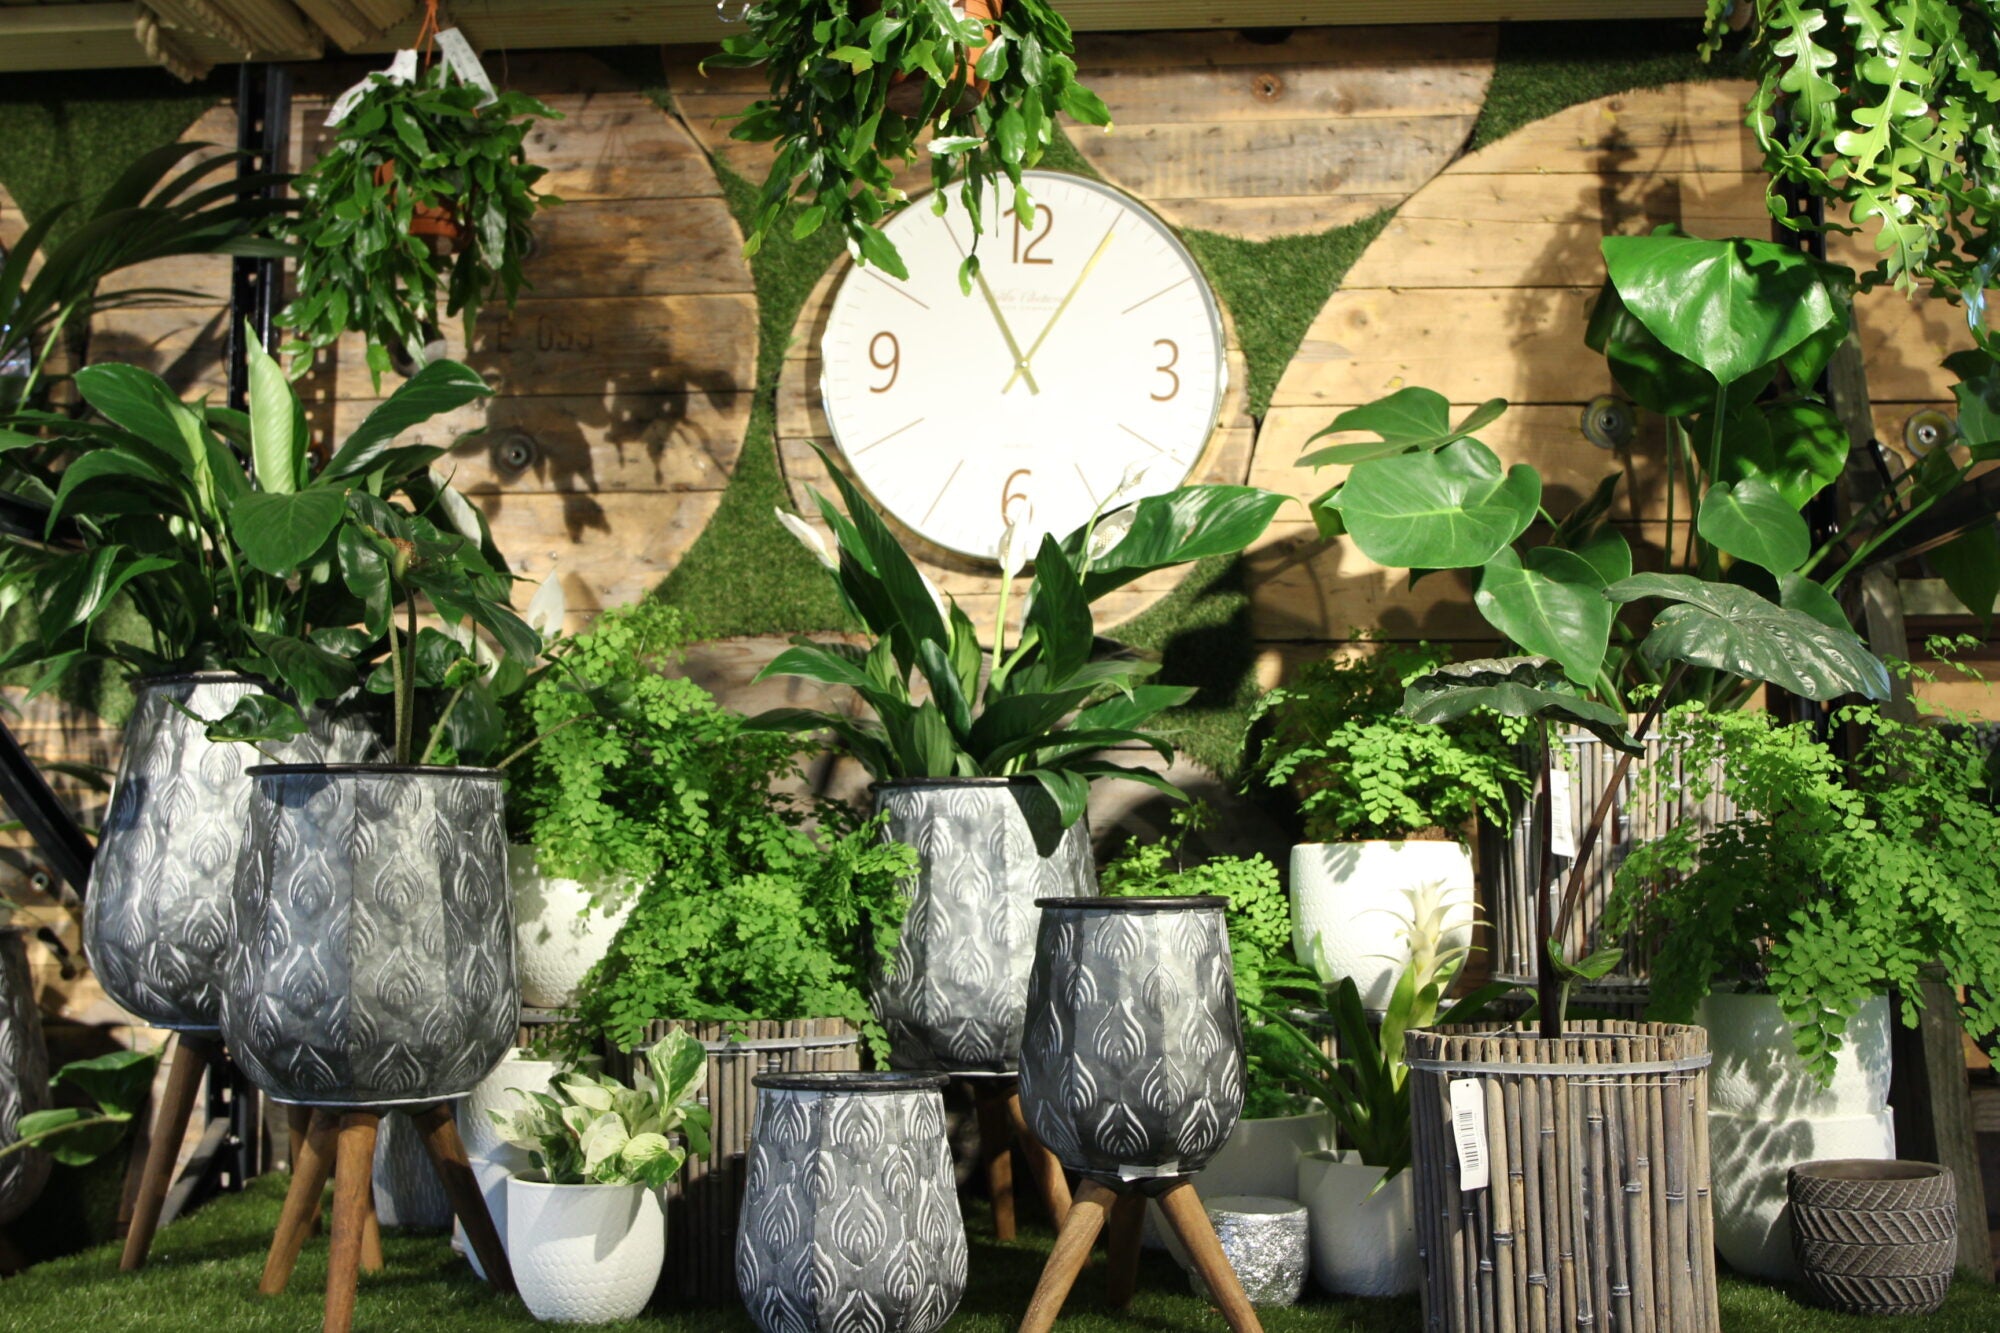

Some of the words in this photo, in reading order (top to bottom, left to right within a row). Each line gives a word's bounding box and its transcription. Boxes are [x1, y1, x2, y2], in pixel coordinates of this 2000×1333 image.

[1003, 203, 1053, 264] 12
[869, 331, 900, 394] 9
[1150, 338, 1180, 402] 3
[1001, 468, 1033, 528] 6
